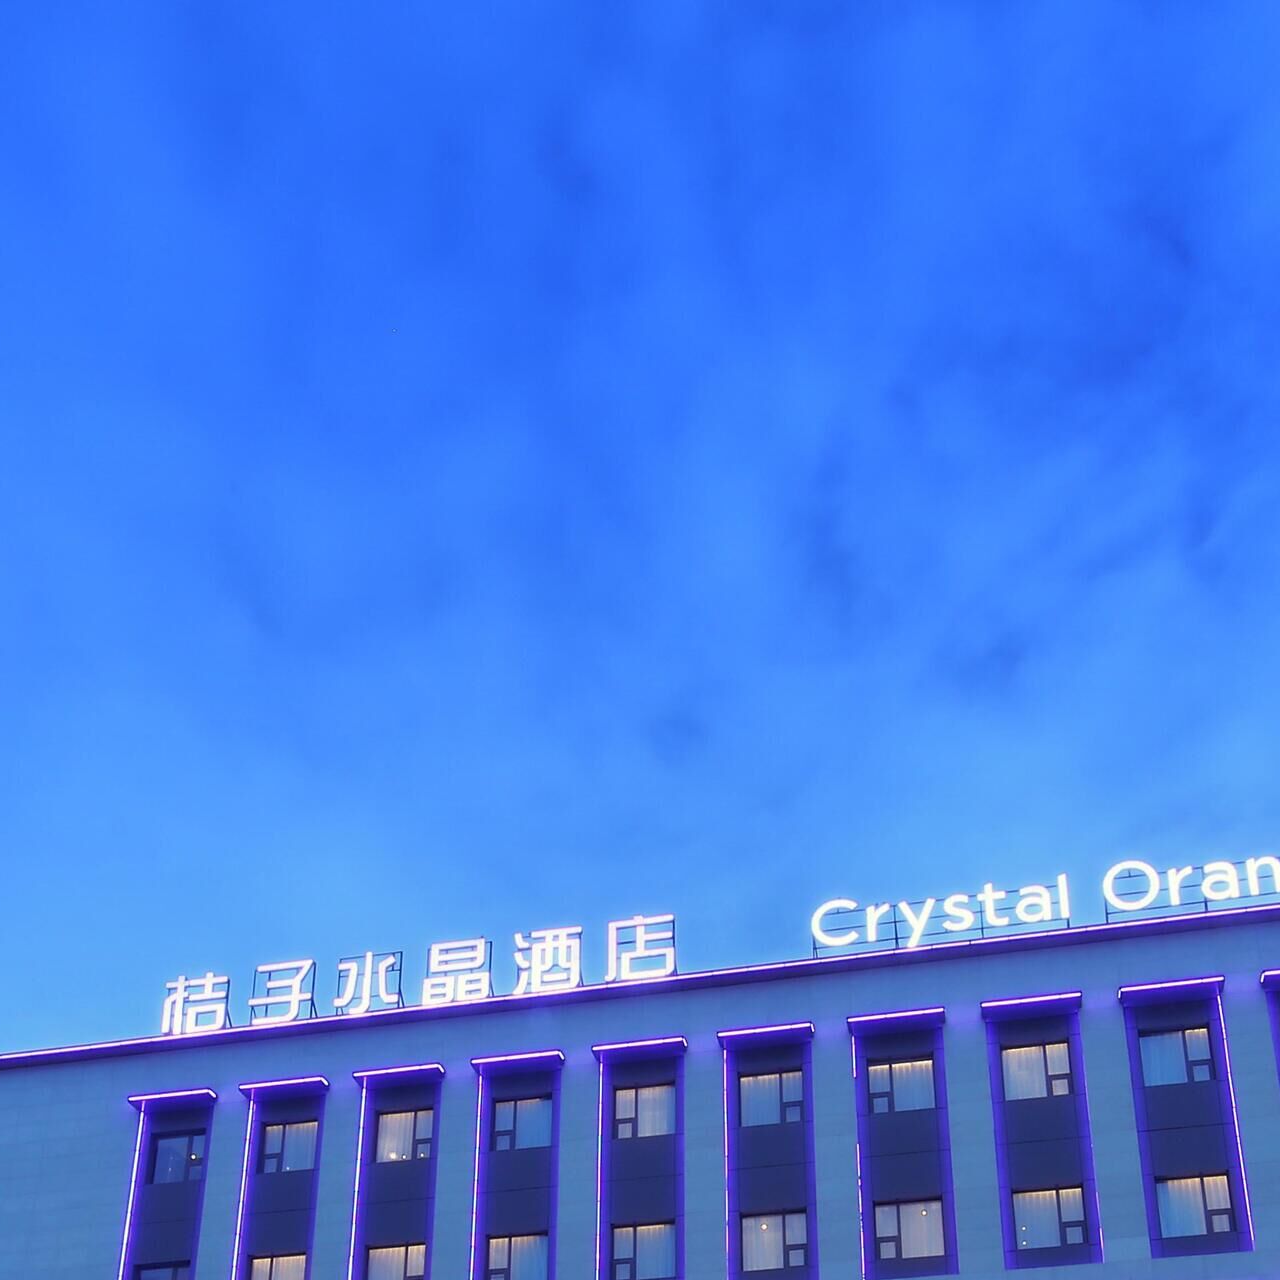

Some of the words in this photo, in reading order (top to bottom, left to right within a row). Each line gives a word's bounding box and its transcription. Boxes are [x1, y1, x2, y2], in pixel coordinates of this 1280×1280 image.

[810, 873, 1070, 949] Crystal
[162, 914, 674, 1035] 桔子水晶酒店
